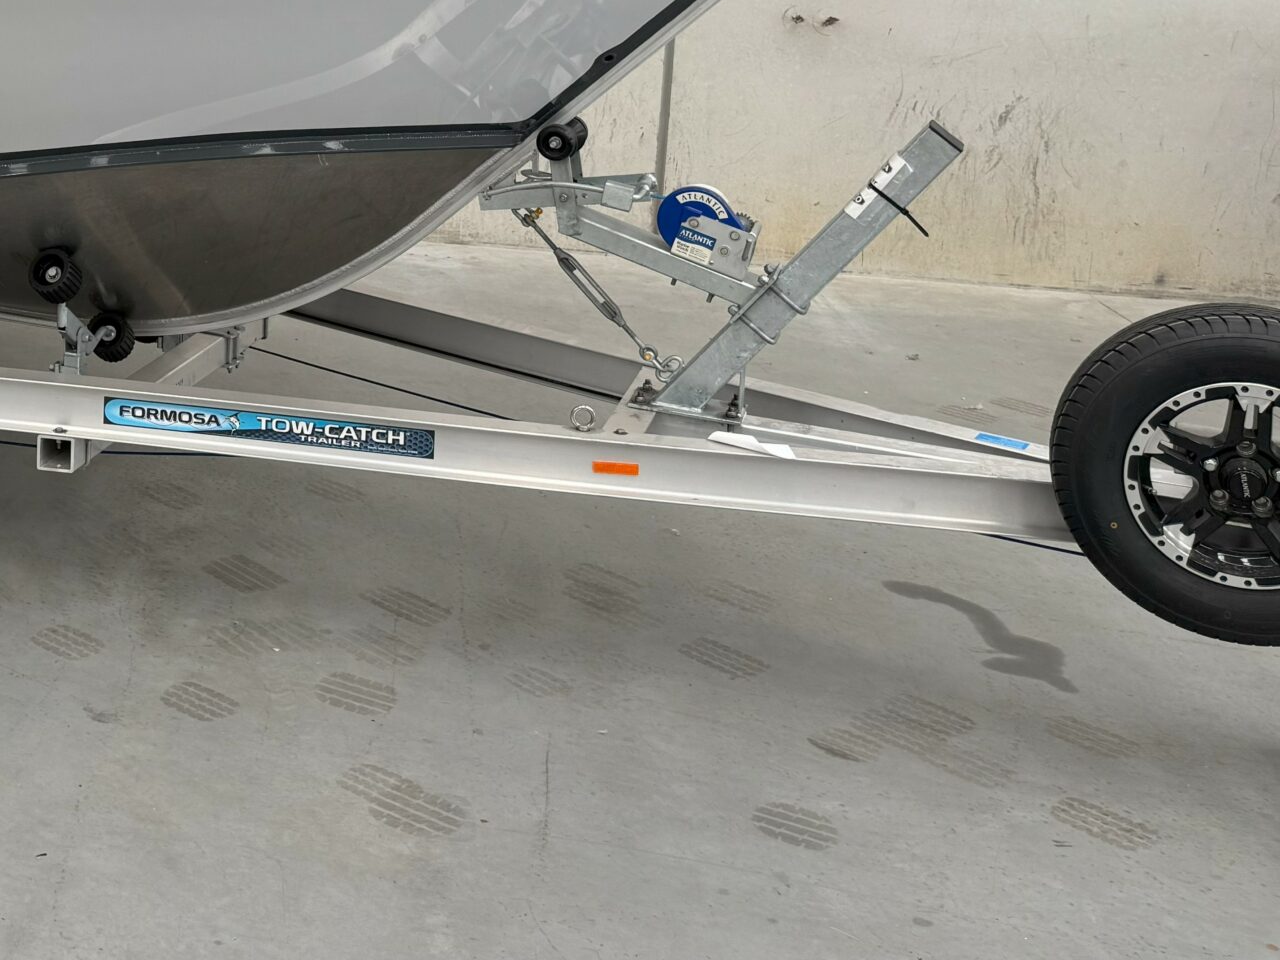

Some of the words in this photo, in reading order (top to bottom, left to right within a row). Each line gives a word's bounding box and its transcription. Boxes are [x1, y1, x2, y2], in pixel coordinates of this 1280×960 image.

[681, 193, 725, 216] ATLANTIC
[680, 229, 714, 247] ATLANTIC
[119, 405, 220, 428] FORMOSA
[257, 416, 405, 445] TOW-CATCH
[300, 435, 360, 448] TRAILER
